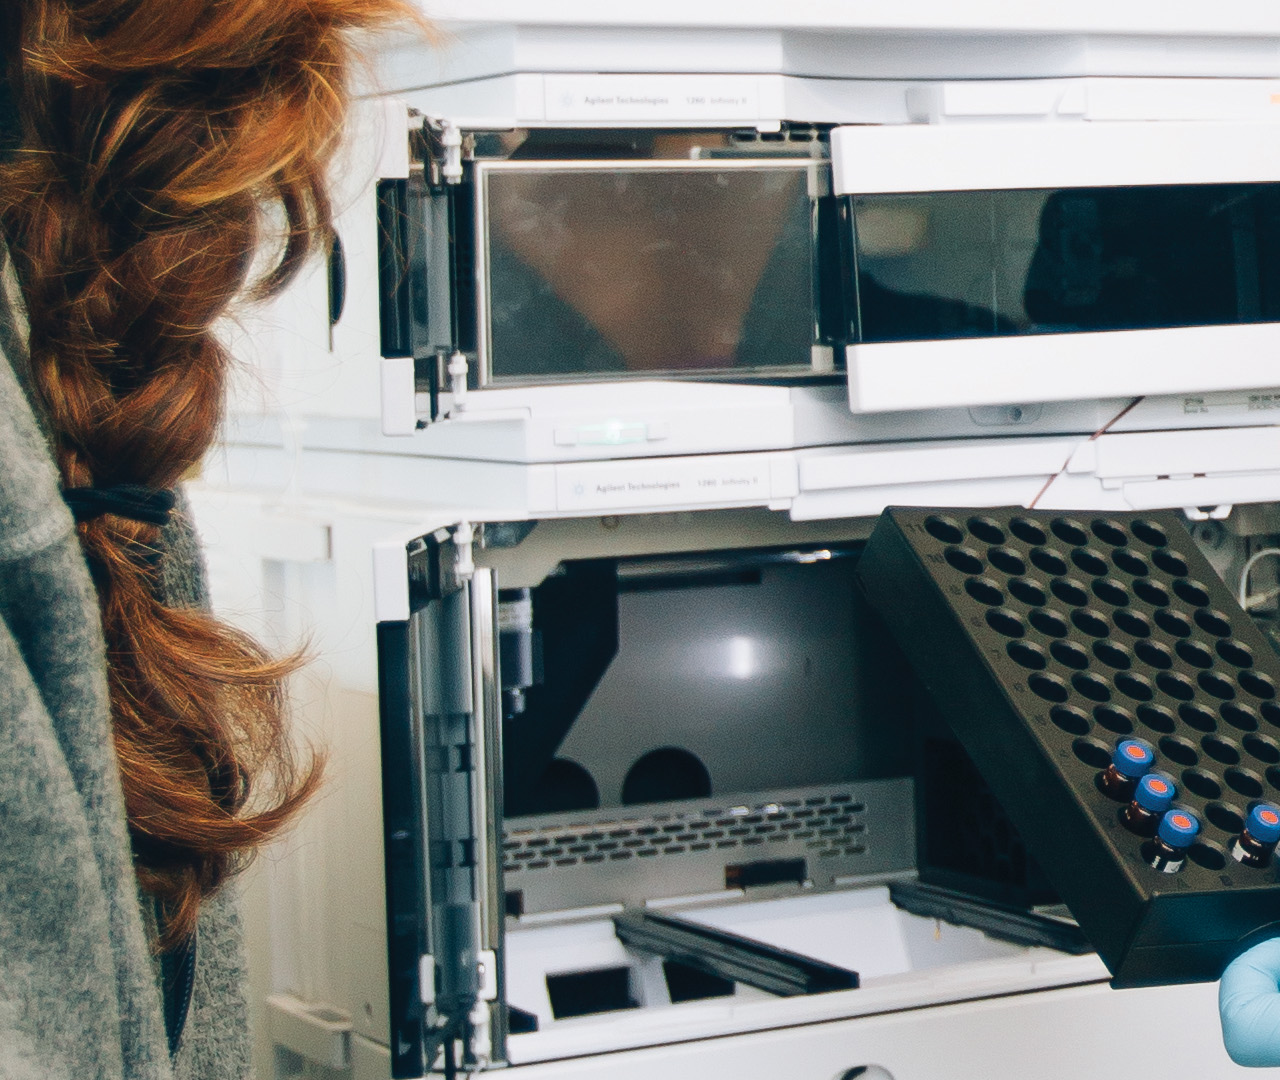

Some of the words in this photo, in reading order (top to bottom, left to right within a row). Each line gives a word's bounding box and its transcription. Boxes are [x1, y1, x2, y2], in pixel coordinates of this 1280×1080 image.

[584, 95, 614, 106] Agilent
[616, 96, 669, 106] Technologies
[596, 483, 626, 494] Agilent
[628, 480, 680, 492] Technologies
